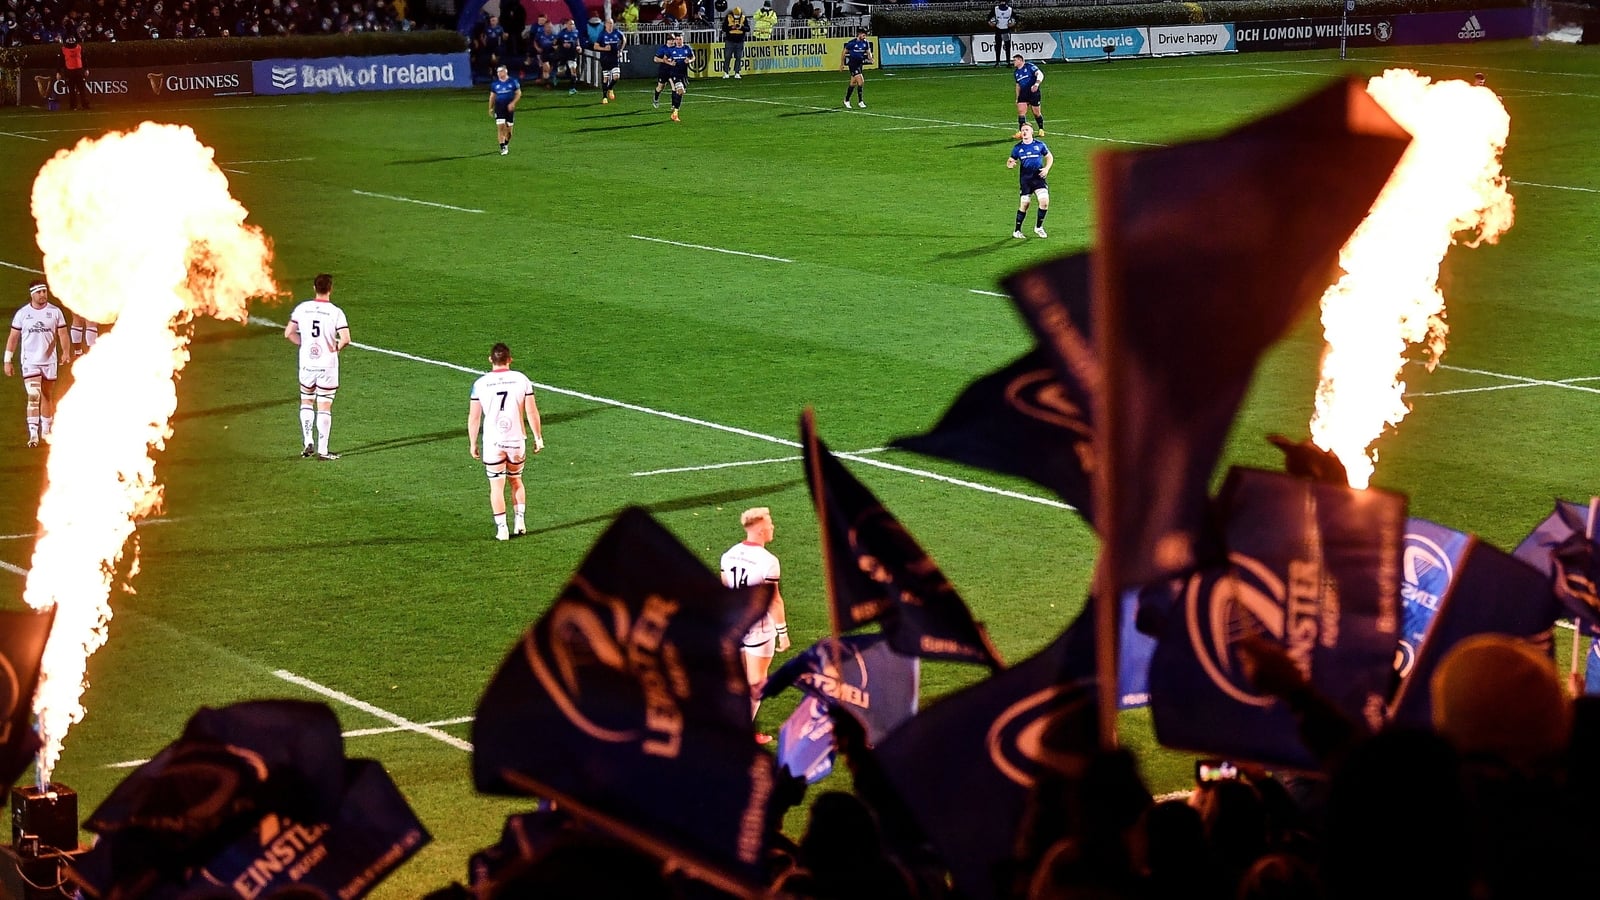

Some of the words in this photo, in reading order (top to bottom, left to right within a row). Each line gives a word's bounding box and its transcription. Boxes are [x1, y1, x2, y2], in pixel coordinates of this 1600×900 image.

[1068, 33, 1133, 49] Windsor.ie
[1158, 33, 1185, 45] Drive
[1186, 32, 1218, 46] happy
[1263, 25, 1313, 41] LOMOND
[1457, 29, 1486, 39] adidas
[772, 44, 789, 57] THE
[791, 43, 828, 56] OFFICIAL
[886, 40, 955, 56] Windsor.ie
[1011, 40, 1044, 54] happy
[752, 57, 800, 71] DOWNLOAD
[801, 55, 823, 69] NOW.
[166, 74, 240, 91] GUINNESS
[302, 64, 355, 88] Bank
[358, 64, 377, 85] of
[382, 62, 455, 84] Ireland
[54, 79, 128, 95] GNNESS
[311, 319, 321, 338] 5
[496, 390, 509, 412] 7
[730, 565, 749, 588] 14
